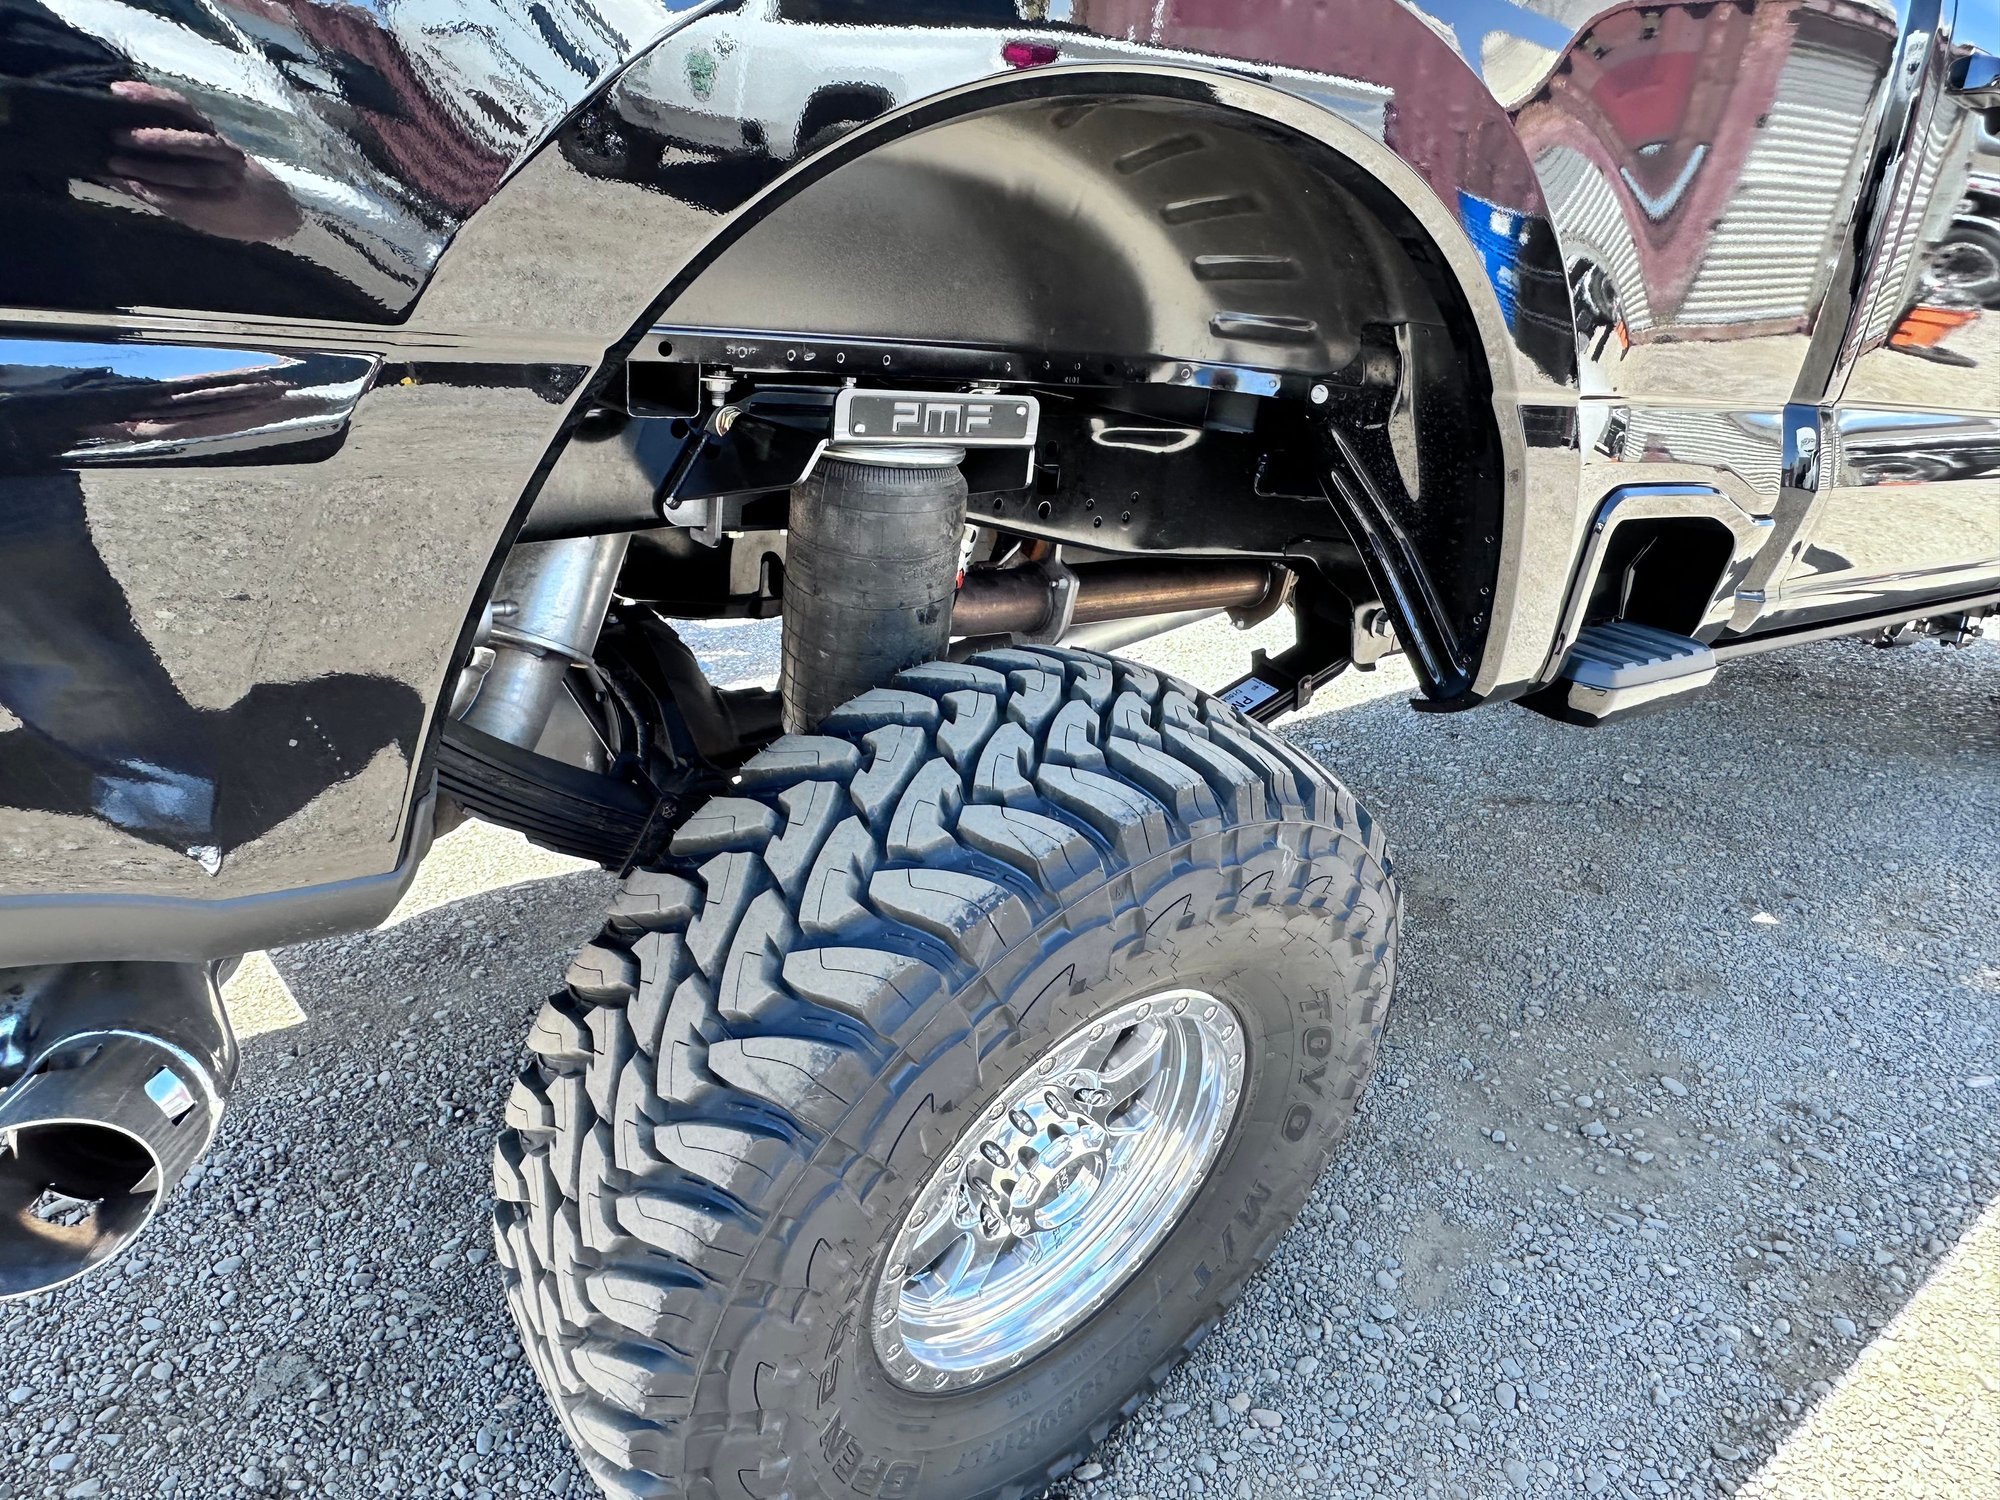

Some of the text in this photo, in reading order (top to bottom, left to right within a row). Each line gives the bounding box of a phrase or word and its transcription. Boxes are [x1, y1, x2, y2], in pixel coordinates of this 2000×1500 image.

[892, 402, 993, 433] PMF
[1282, 987, 1333, 1143] TOYO
[819, 1407, 926, 1499] OPEN
